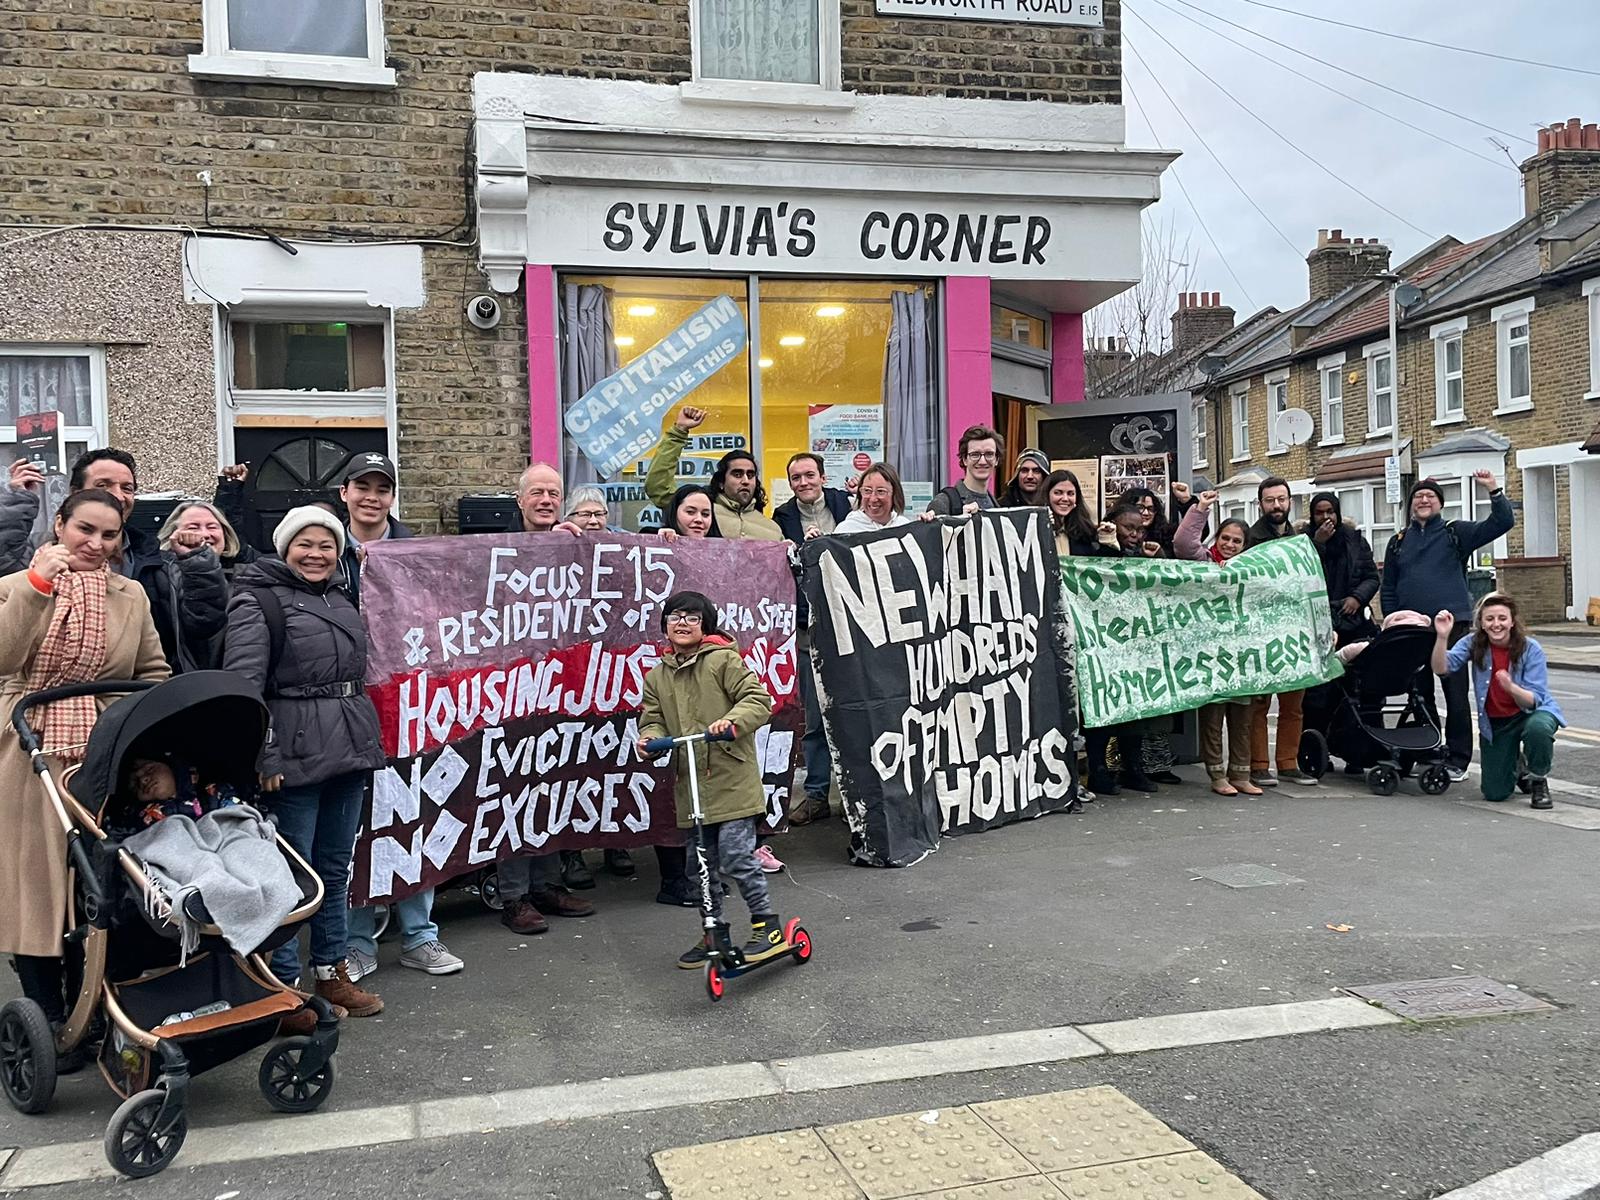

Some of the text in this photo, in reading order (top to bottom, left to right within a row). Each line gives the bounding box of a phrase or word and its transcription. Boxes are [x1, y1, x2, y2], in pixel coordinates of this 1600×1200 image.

[1017, 0, 1072, 13] ROAD
[603, 201, 1051, 265] SYLVIA'S CORNER
[567, 297, 737, 434] CAPITALISM
[588, 338, 737, 456] CAN'T SOLVE THIS
[601, 428, 657, 477] MESS!
[698, 436, 746, 450] NEED
[590, 543, 674, 604] E15
[818, 513, 1046, 656] NEWHAM
[403, 628, 430, 666] &
[438, 598, 611, 663] RESIDENTS
[904, 612, 1039, 705] HUNDREDS
[1086, 630, 1313, 718] Homelessness
[399, 655, 564, 758] HOUSING
[870, 666, 1033, 796] OF EMPTY
[371, 744, 470, 831] NO
[935, 727, 1072, 833] HOMES
[369, 806, 468, 899] NO
[467, 771, 656, 865] EXCUSES
